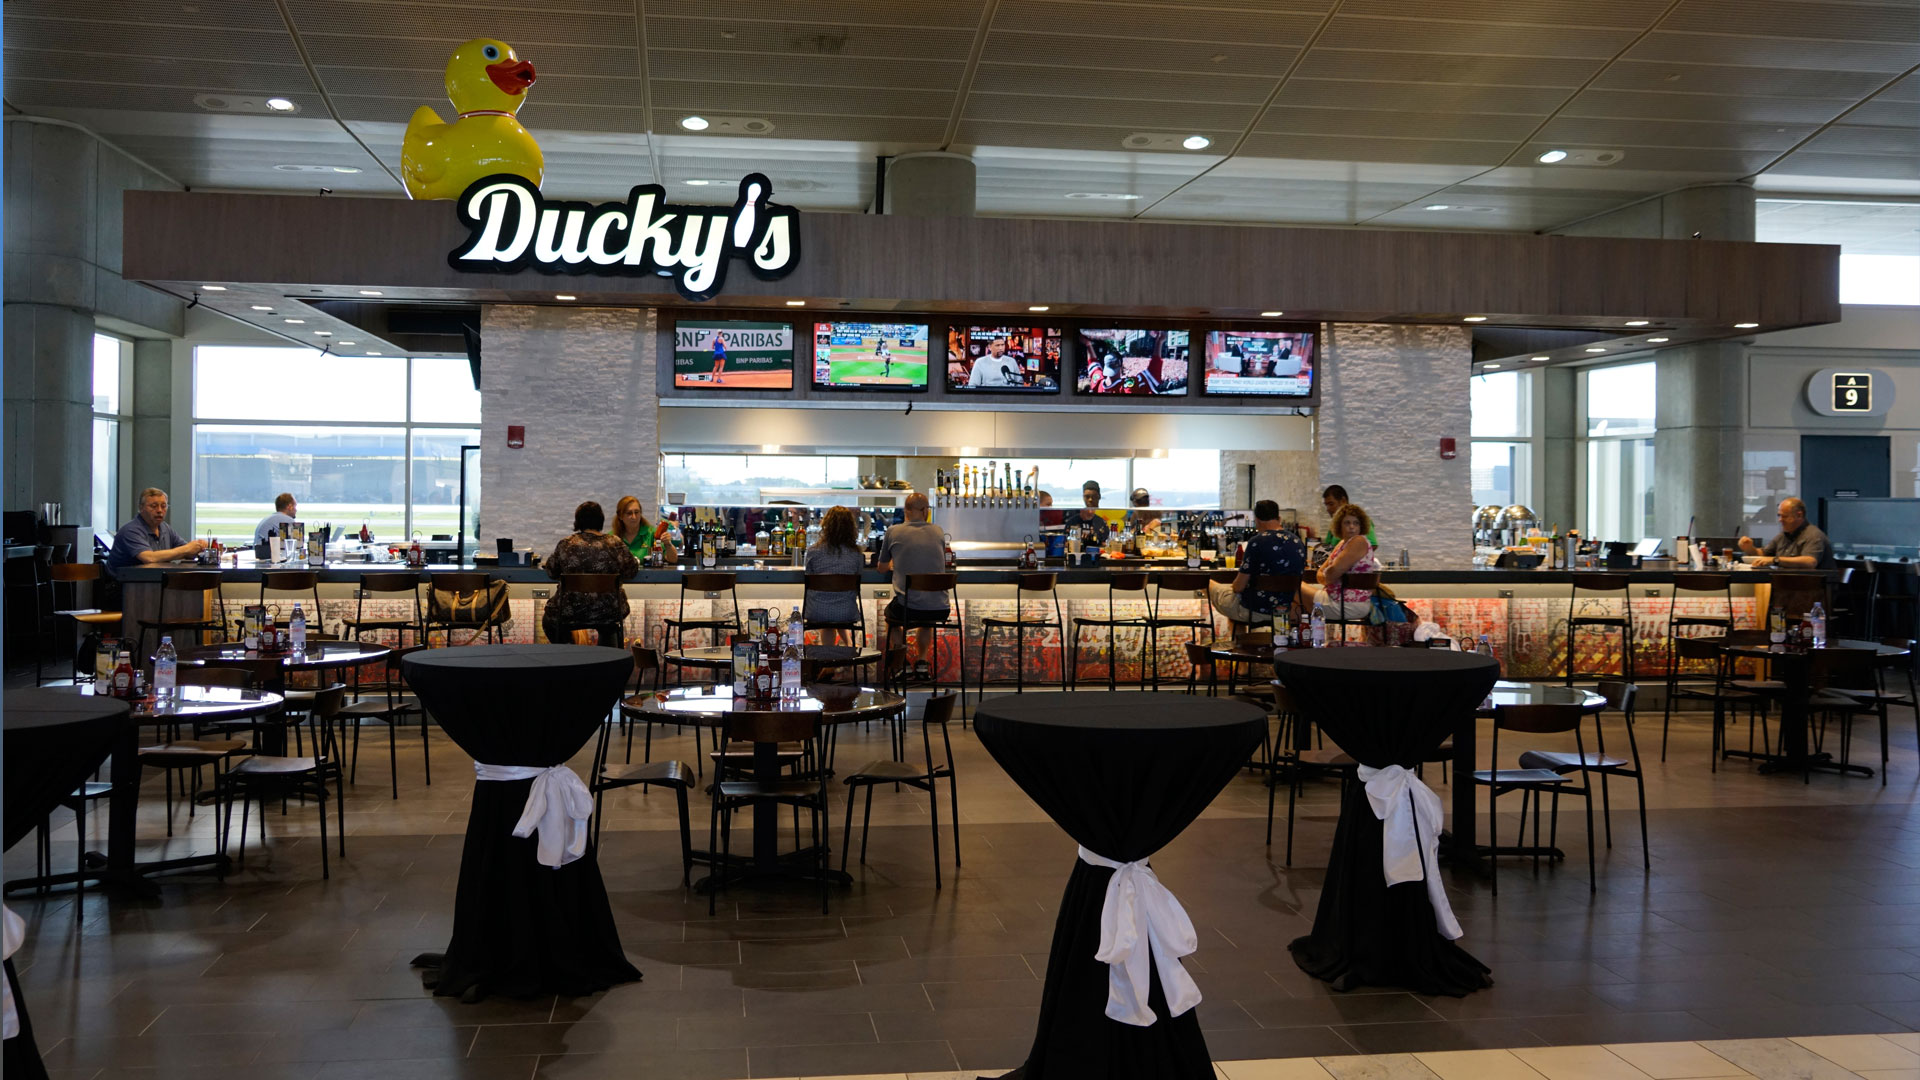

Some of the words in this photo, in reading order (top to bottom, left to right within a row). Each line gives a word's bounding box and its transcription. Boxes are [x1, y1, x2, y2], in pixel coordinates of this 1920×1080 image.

[459, 183, 791, 292] Ducky's
[722, 332, 783, 347] PARIBAS
[1847, 376, 1856, 386] A
[1845, 389, 1858, 406] 9
